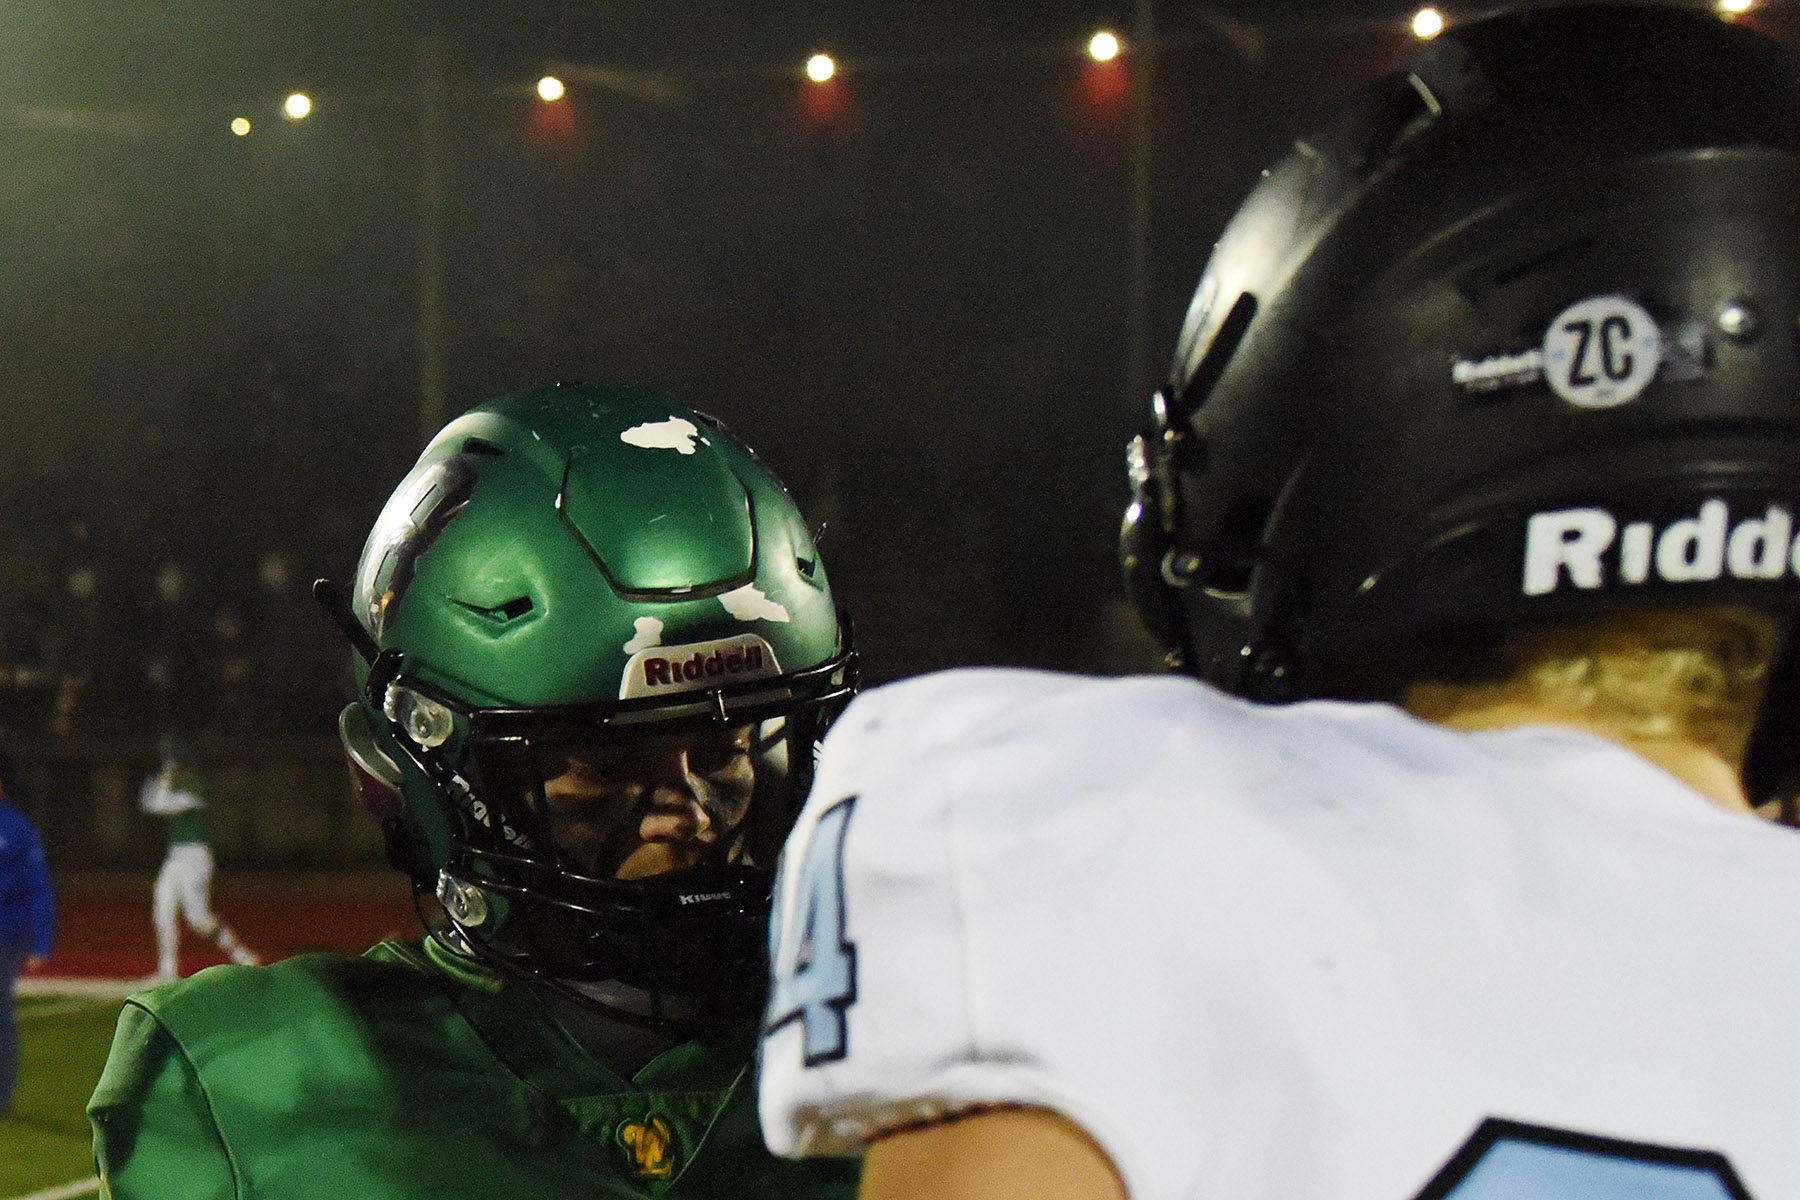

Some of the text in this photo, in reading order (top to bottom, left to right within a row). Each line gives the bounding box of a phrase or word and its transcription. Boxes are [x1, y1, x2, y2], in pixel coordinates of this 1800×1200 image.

[1565, 315, 1633, 386] ZC
[1521, 496, 1800, 596] Ridd
[643, 645, 763, 686] Riddell
